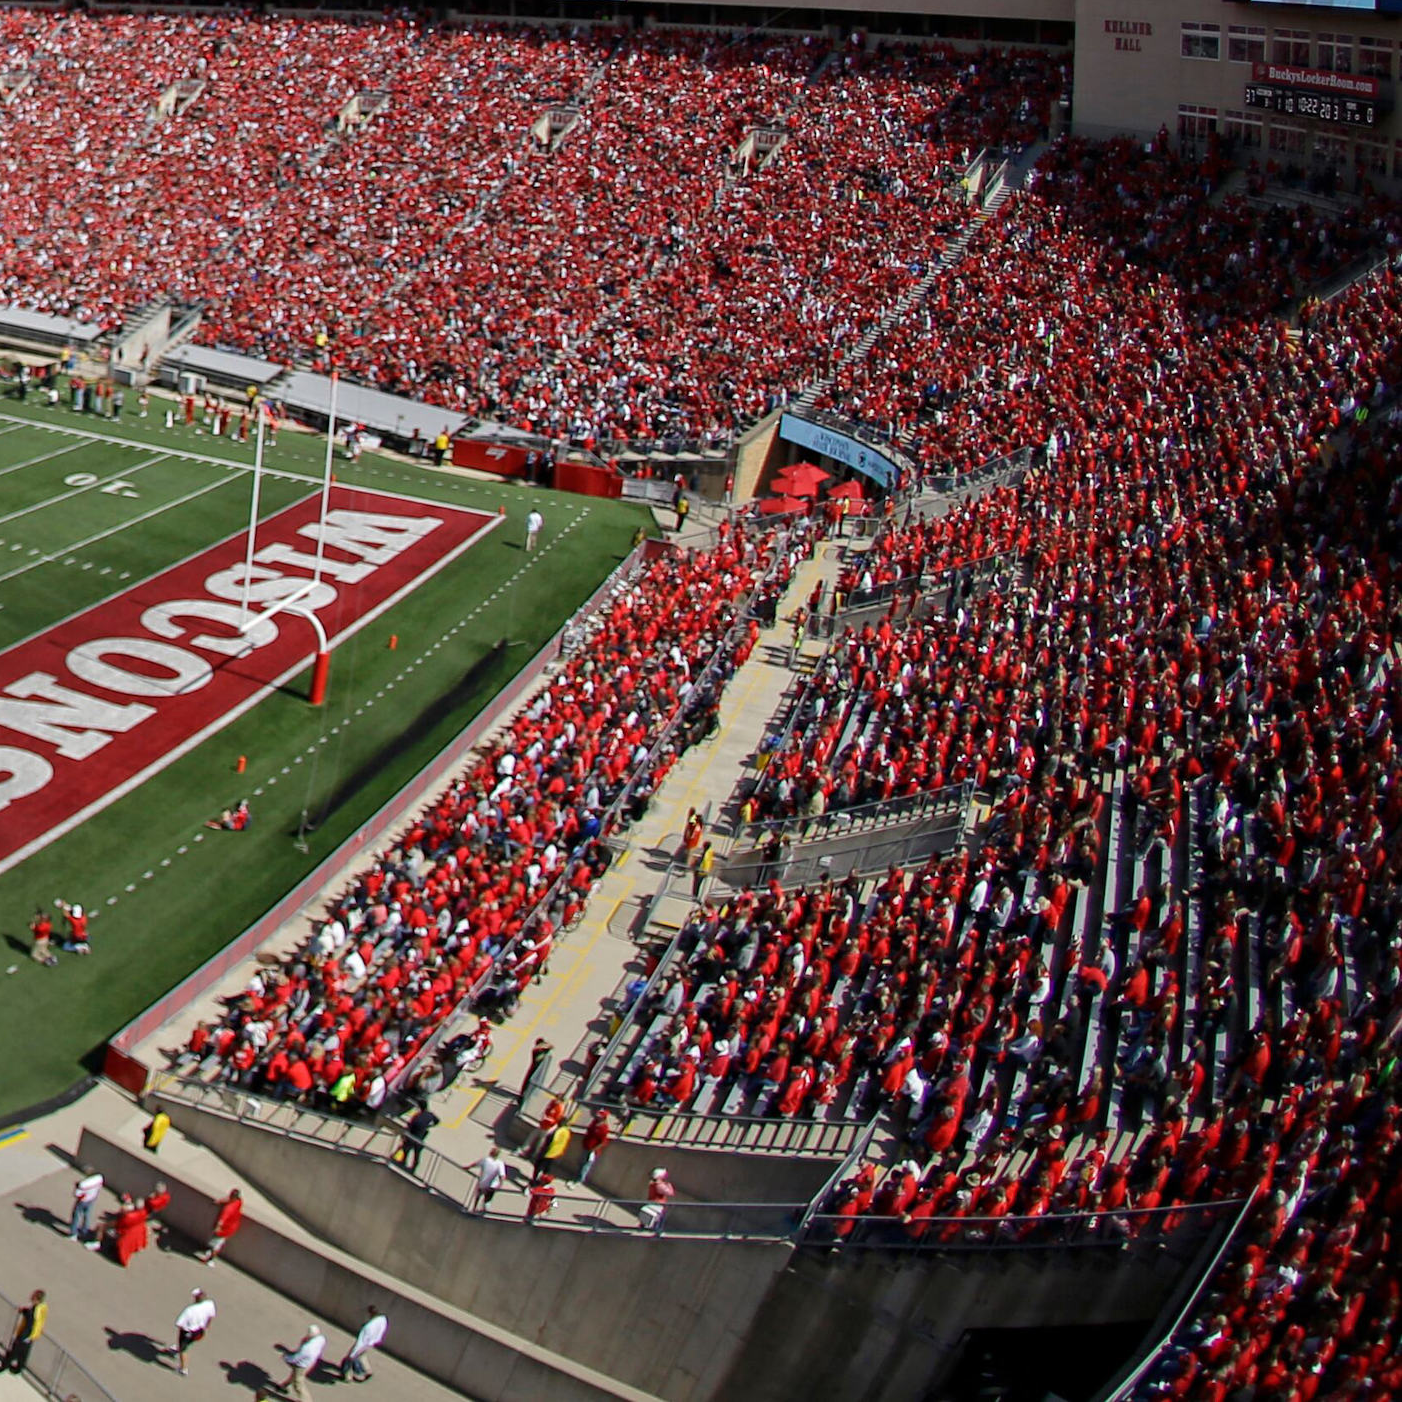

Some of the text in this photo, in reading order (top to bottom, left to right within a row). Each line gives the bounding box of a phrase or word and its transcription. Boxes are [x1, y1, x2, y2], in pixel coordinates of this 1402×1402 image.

[1104, 20, 1152, 36] KELLNER
[1115, 37, 1141, 52] HALL
[1269, 66, 1373, 93] BuckysLockerRoom.com
[1246, 89, 1255, 102] 37
[1285, 98, 1294, 112] 10
[1298, 97, 1318, 114] 10:22
[1320, 103, 1331, 119] 20
[1334, 105, 1339, 120] 3
[1366, 107, 1373, 123] 0
